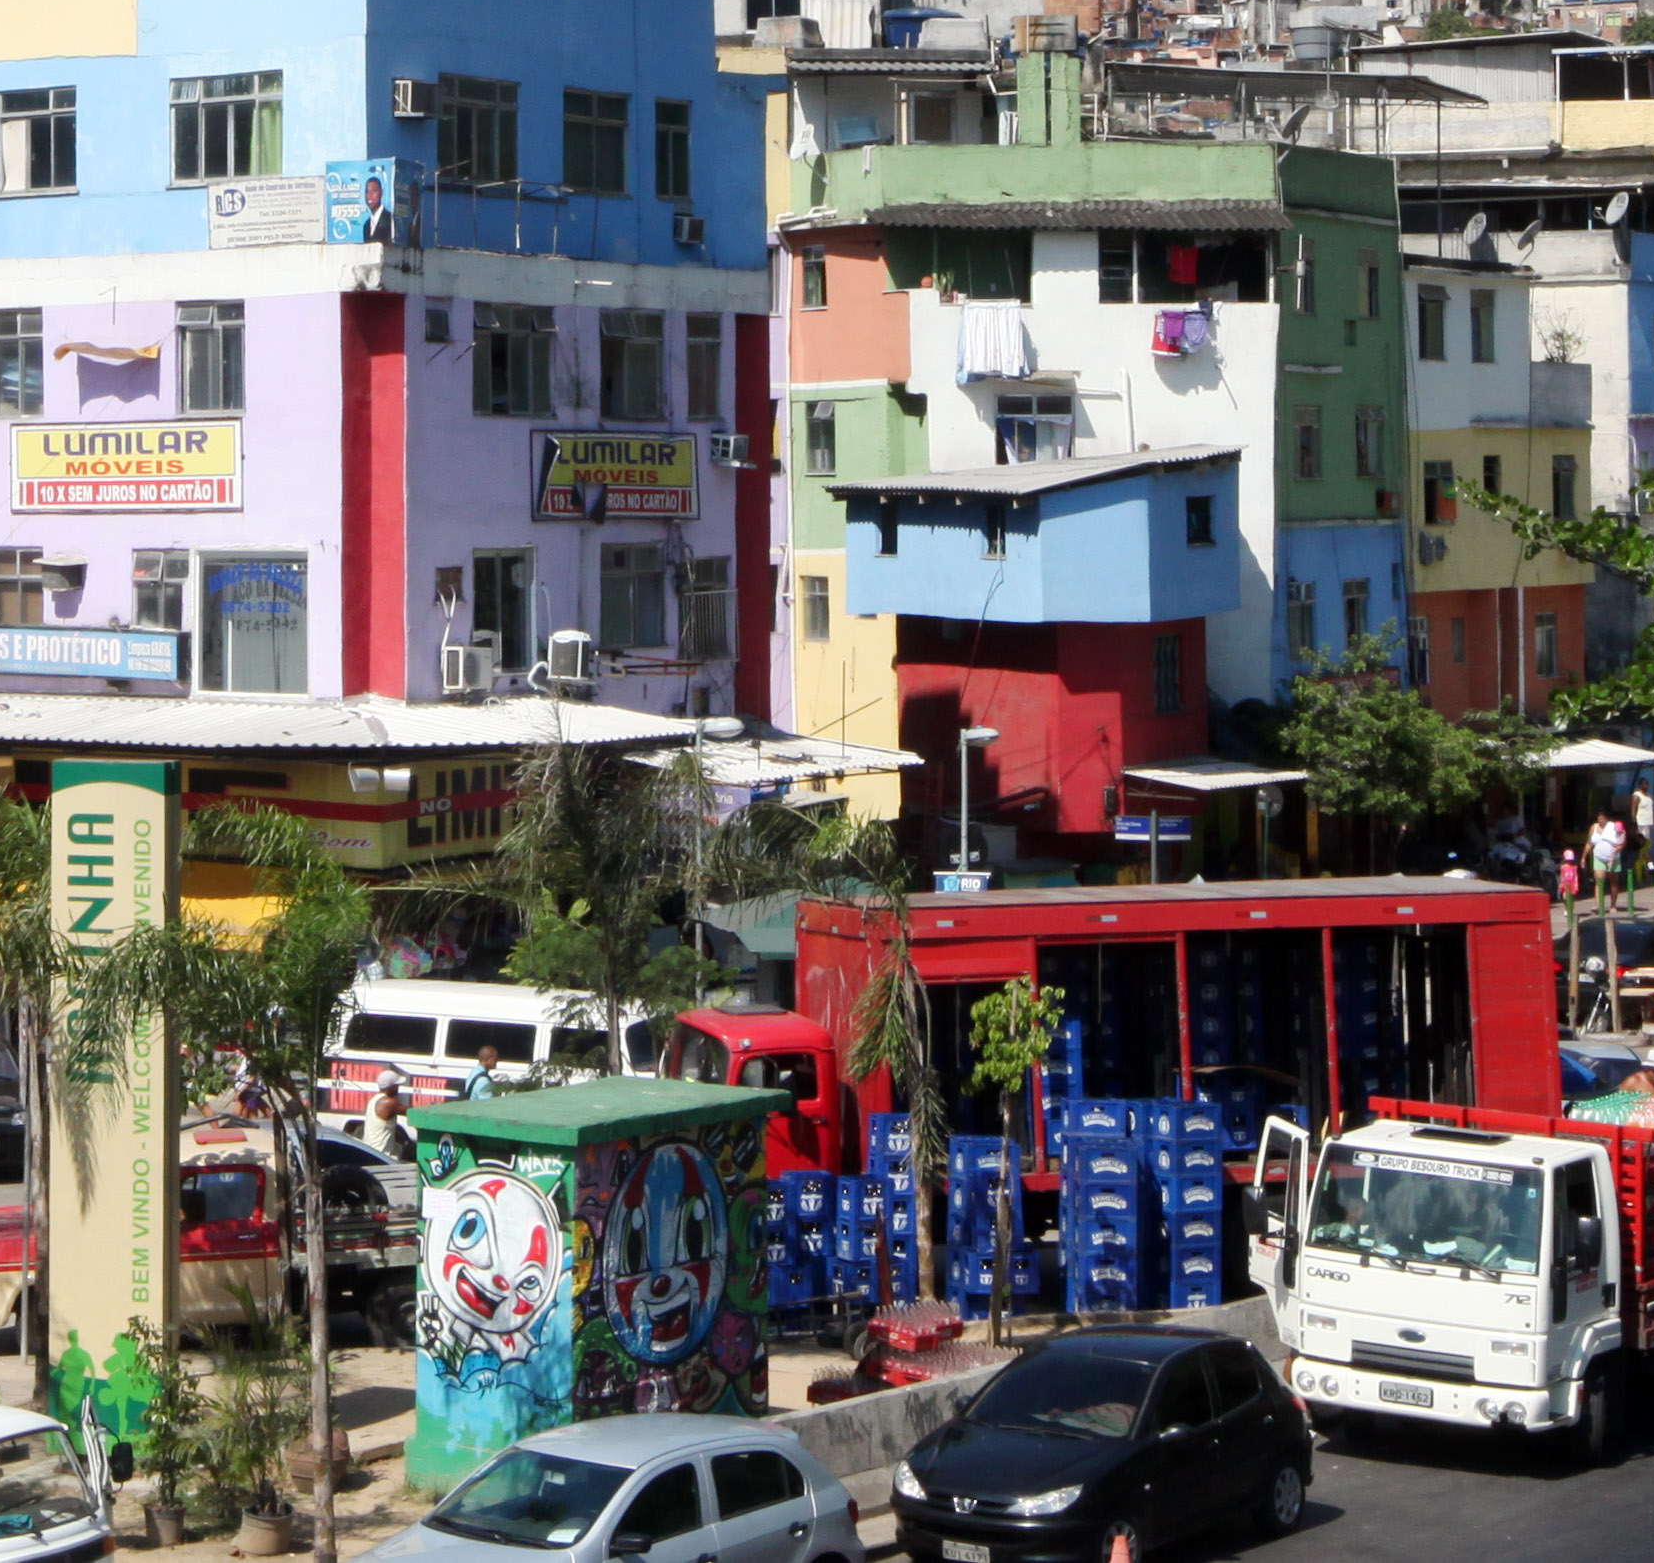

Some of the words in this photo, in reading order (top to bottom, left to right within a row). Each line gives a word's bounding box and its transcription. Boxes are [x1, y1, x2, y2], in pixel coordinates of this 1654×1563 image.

[215, 190, 243, 214] RCS
[43, 430, 209, 456] LUMILAR
[557, 440, 677, 466] LUMILAR
[65, 457, 185, 476] MÓVEIS
[573, 466, 660, 484] MÓVEIS
[40, 485, 54, 502] 10
[56, 485, 67, 502] X
[68, 485, 93, 502] SEM
[96, 484, 137, 502] JUROS
[139, 484, 158, 501] NO
[160, 481, 212, 501] CARTÃO
[627, 493, 641, 509] NO
[642, 491, 677, 509] CARTÃO
[13, 635, 22, 660] E
[26, 632, 121, 665] PROTÉTICO
[419, 798, 453, 813] NO
[133, 819, 152, 927] VENIDO
[961, 877, 982, 889] RIO
[133, 1004, 152, 1134] WELCOM
[1380, 1156, 1409, 1169] GRUPO
[1410, 1159, 1451, 1174] BESOURO
[1452, 1165, 1480, 1179] TRUCK
[131, 1158, 151, 1239] VINDO
[131, 1248, 150, 1303] BEM
[1306, 1266, 1351, 1283] CARGO
